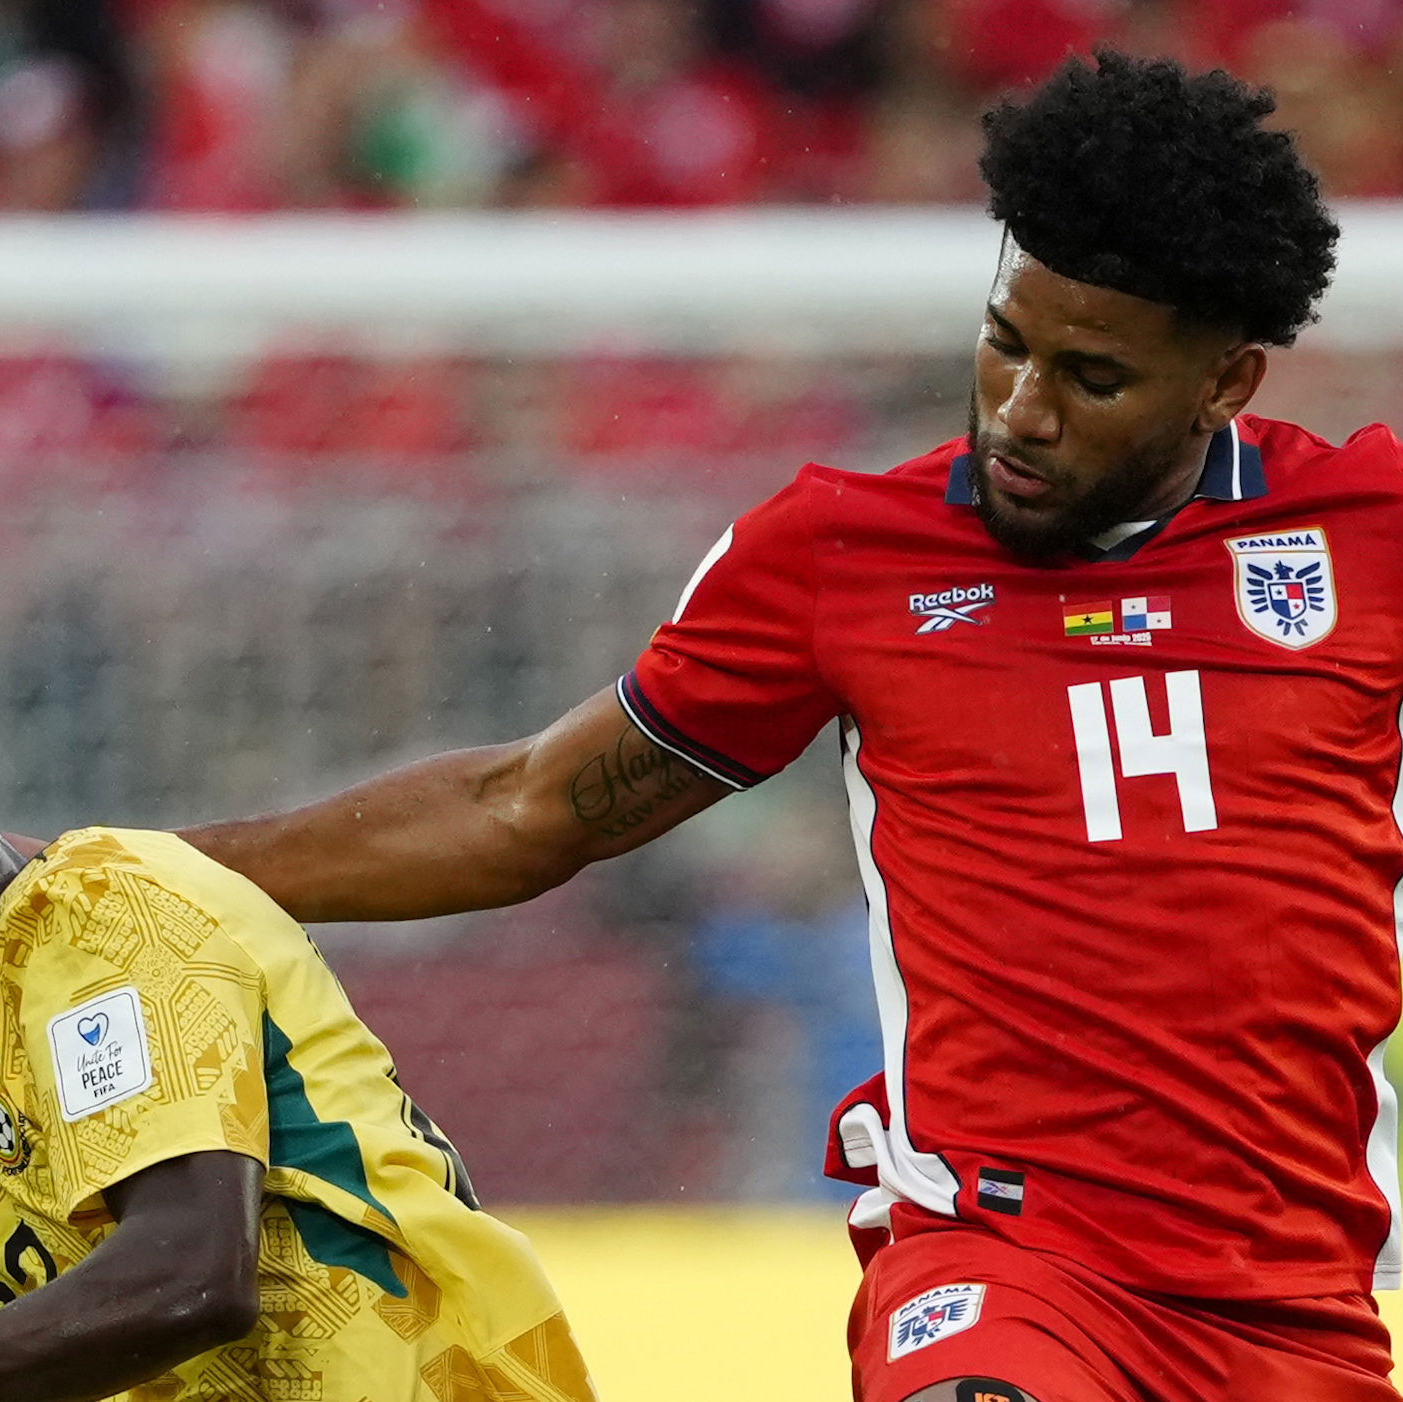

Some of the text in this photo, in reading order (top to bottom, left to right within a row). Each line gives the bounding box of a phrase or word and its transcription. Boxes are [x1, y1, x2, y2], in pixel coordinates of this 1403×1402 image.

[908, 582, 995, 612] Reebok
[1066, 669, 1219, 843] 14
[77, 1040, 124, 1073] Unite For
[81, 1060, 124, 1090] PEACE
[93, 1083, 116, 1098] FIFA
